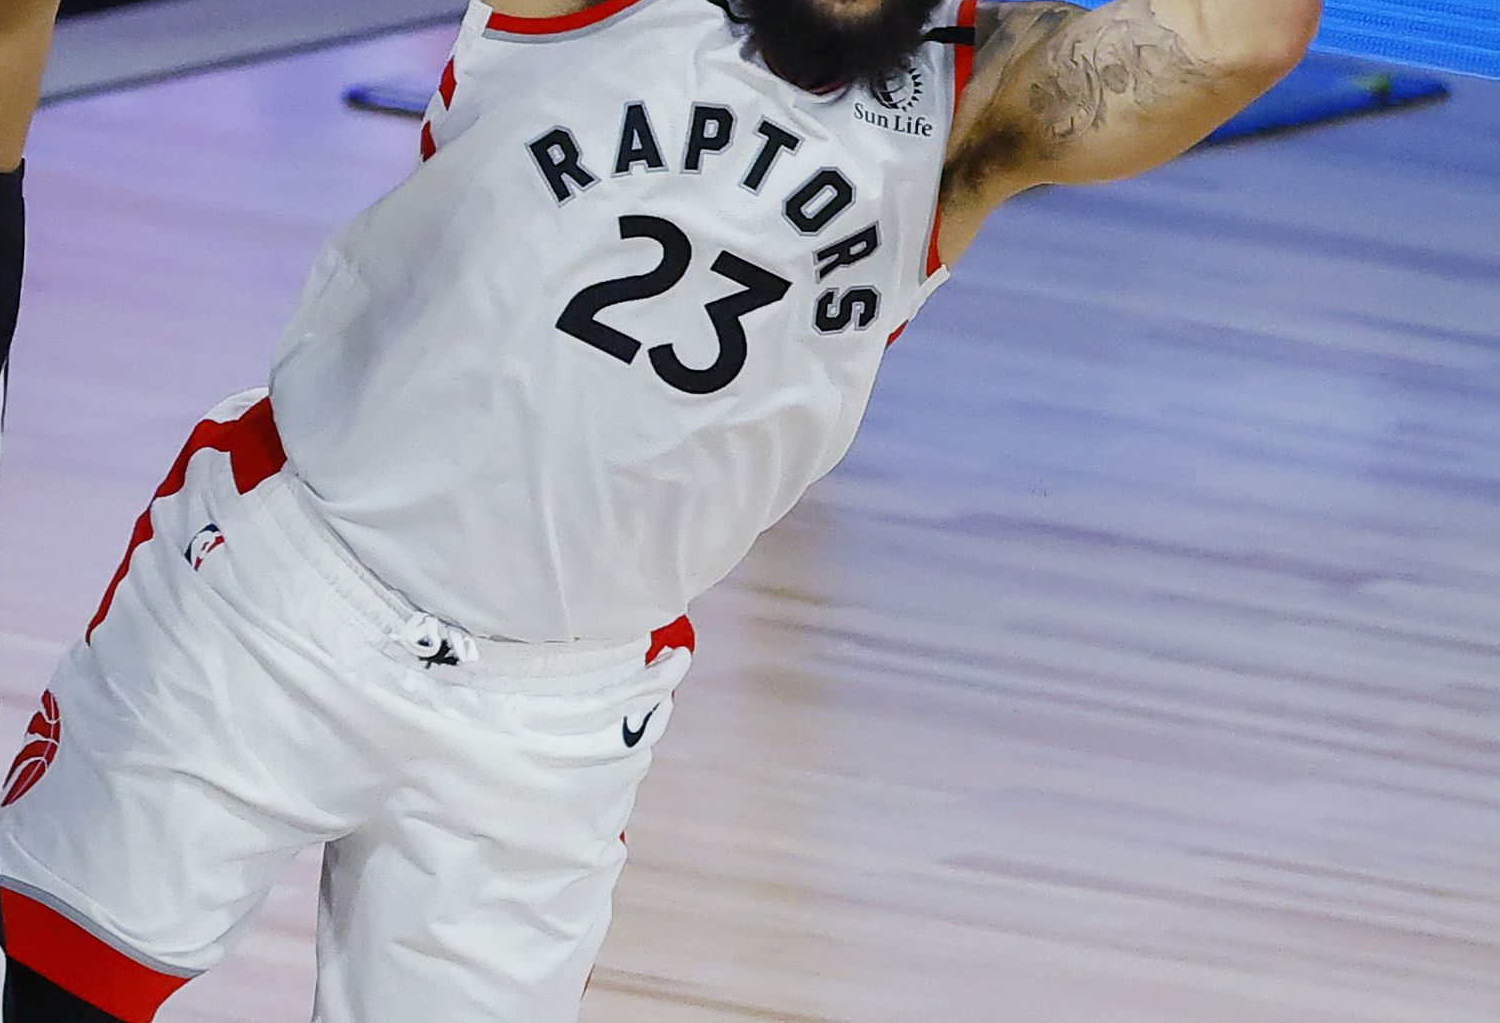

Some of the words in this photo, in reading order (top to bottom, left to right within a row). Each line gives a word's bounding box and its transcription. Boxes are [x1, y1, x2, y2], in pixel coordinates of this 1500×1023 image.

[853, 102, 889, 129] Sun
[893, 114, 933, 137] Life
[525, 100, 883, 336] RAPTORS
[555, 214, 794, 395] 23
